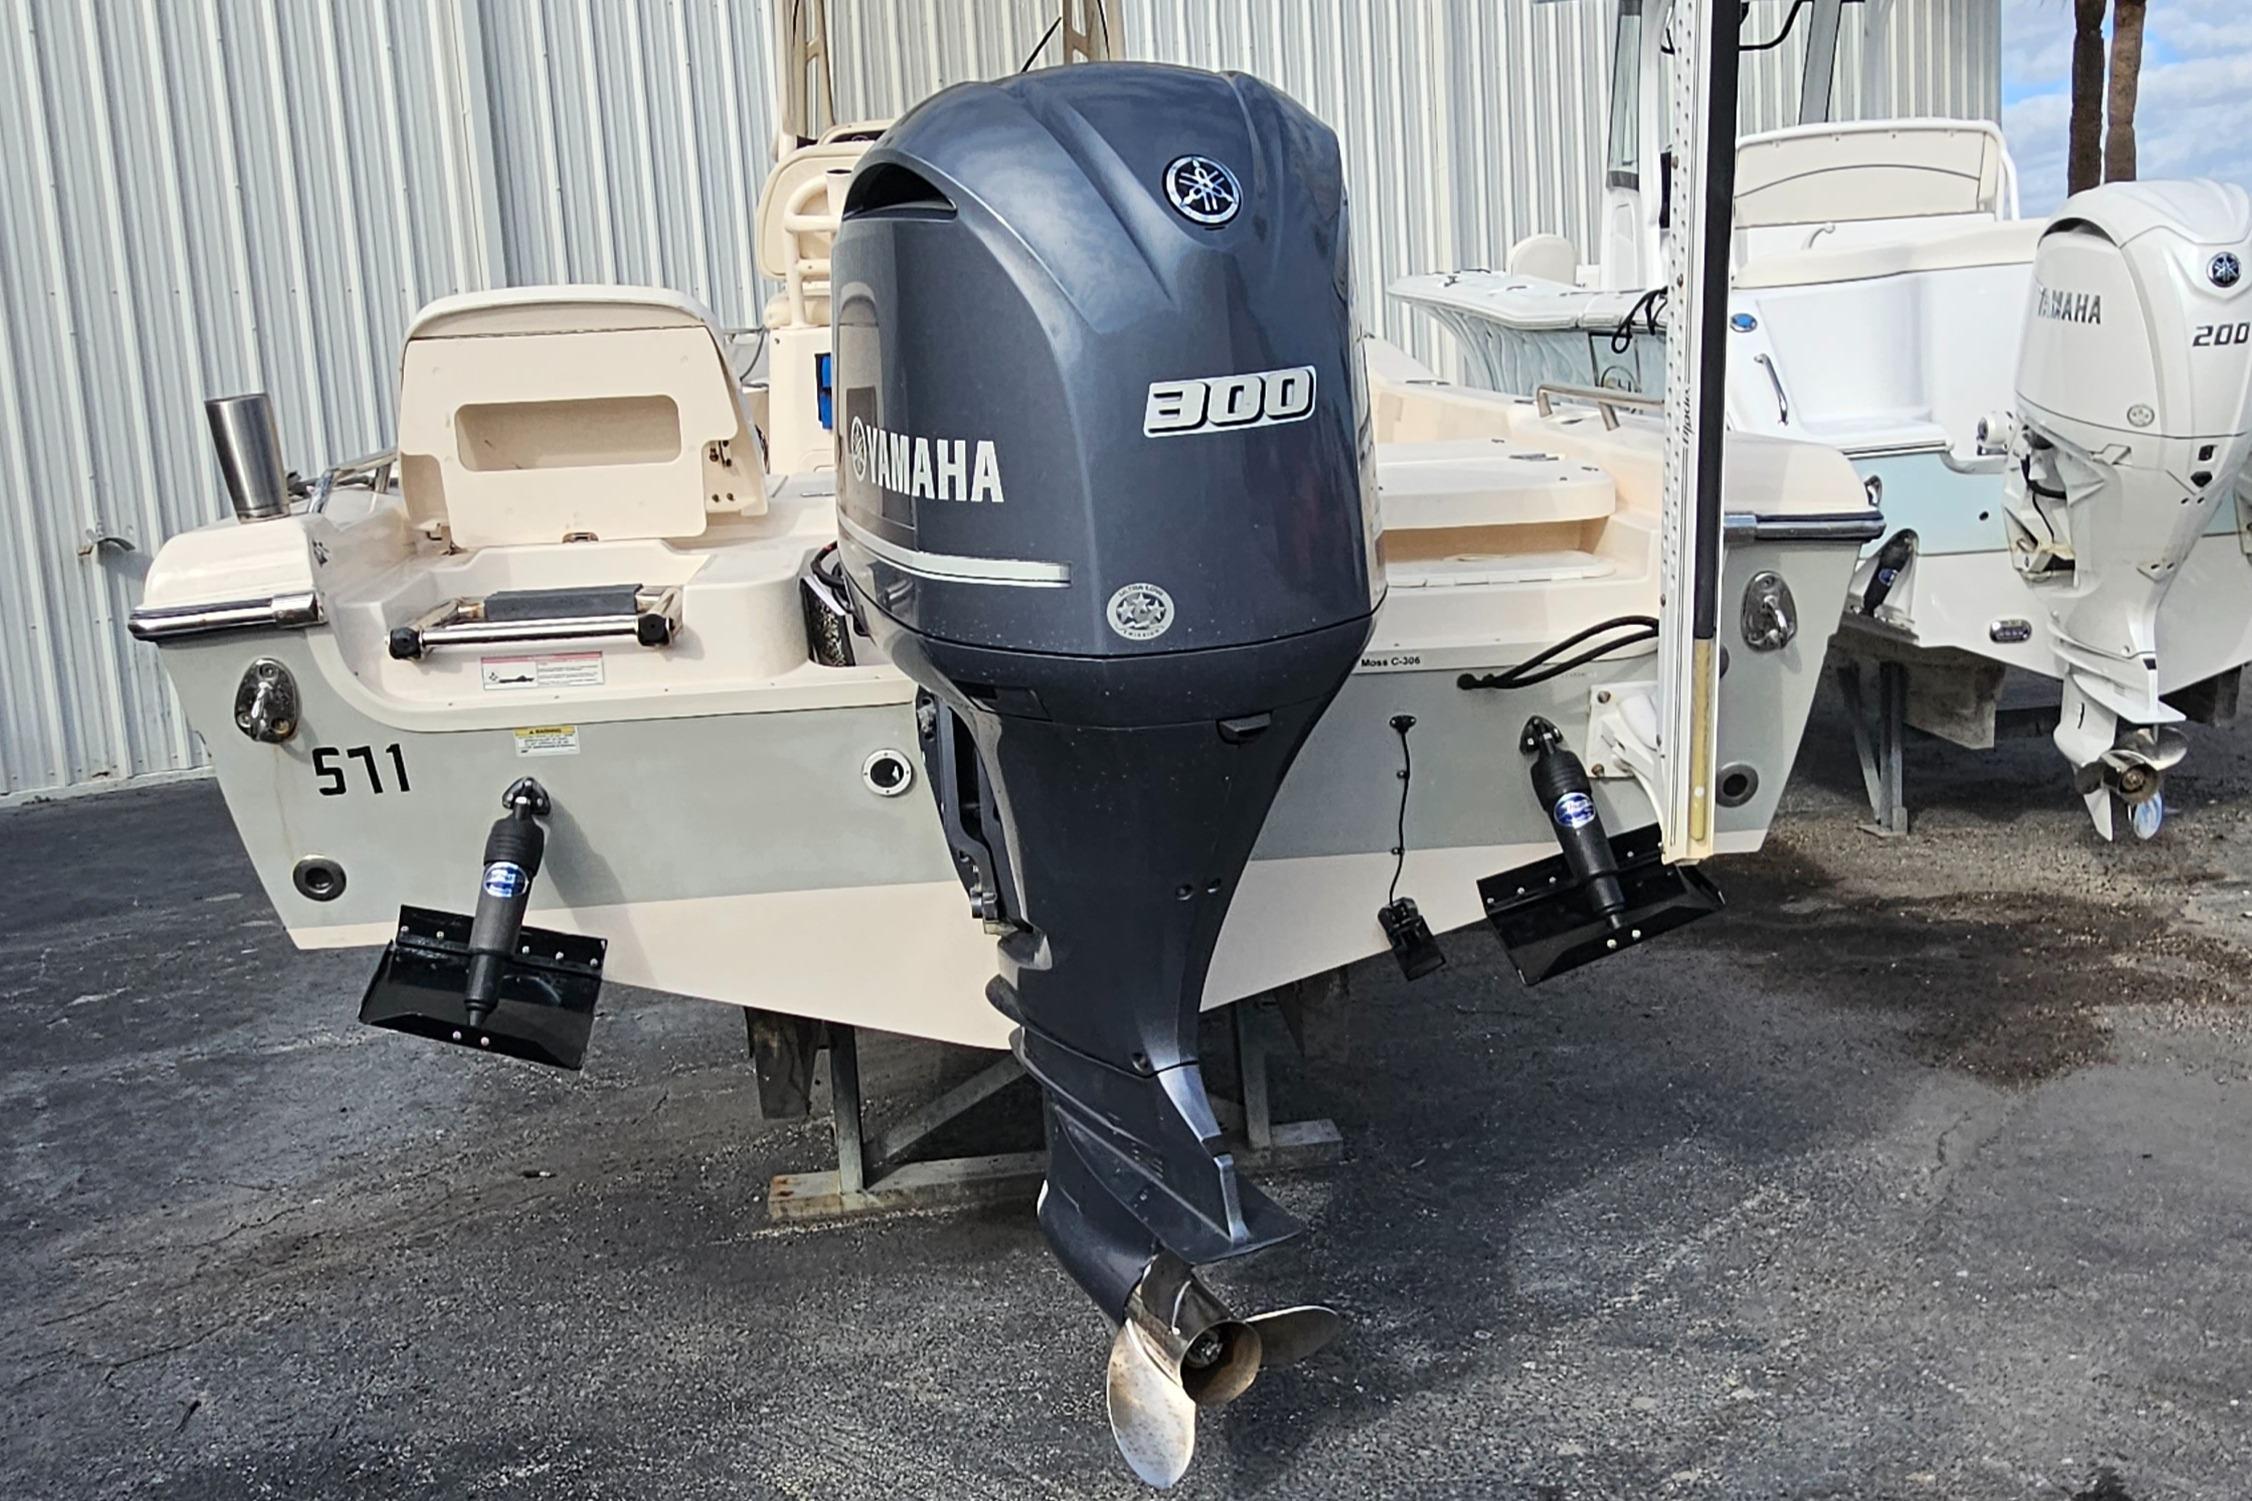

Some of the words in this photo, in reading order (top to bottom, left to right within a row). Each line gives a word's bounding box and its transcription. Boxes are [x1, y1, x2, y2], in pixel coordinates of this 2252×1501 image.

[2037, 287, 2101, 325] YAMAHA
[2192, 321, 2251, 347] 200
[1146, 367, 1314, 436] 300
[865, 424, 1004, 503] YAMAHA
[1361, 658, 1388, 667] Moss
[1391, 656, 1421, 666] C-306
